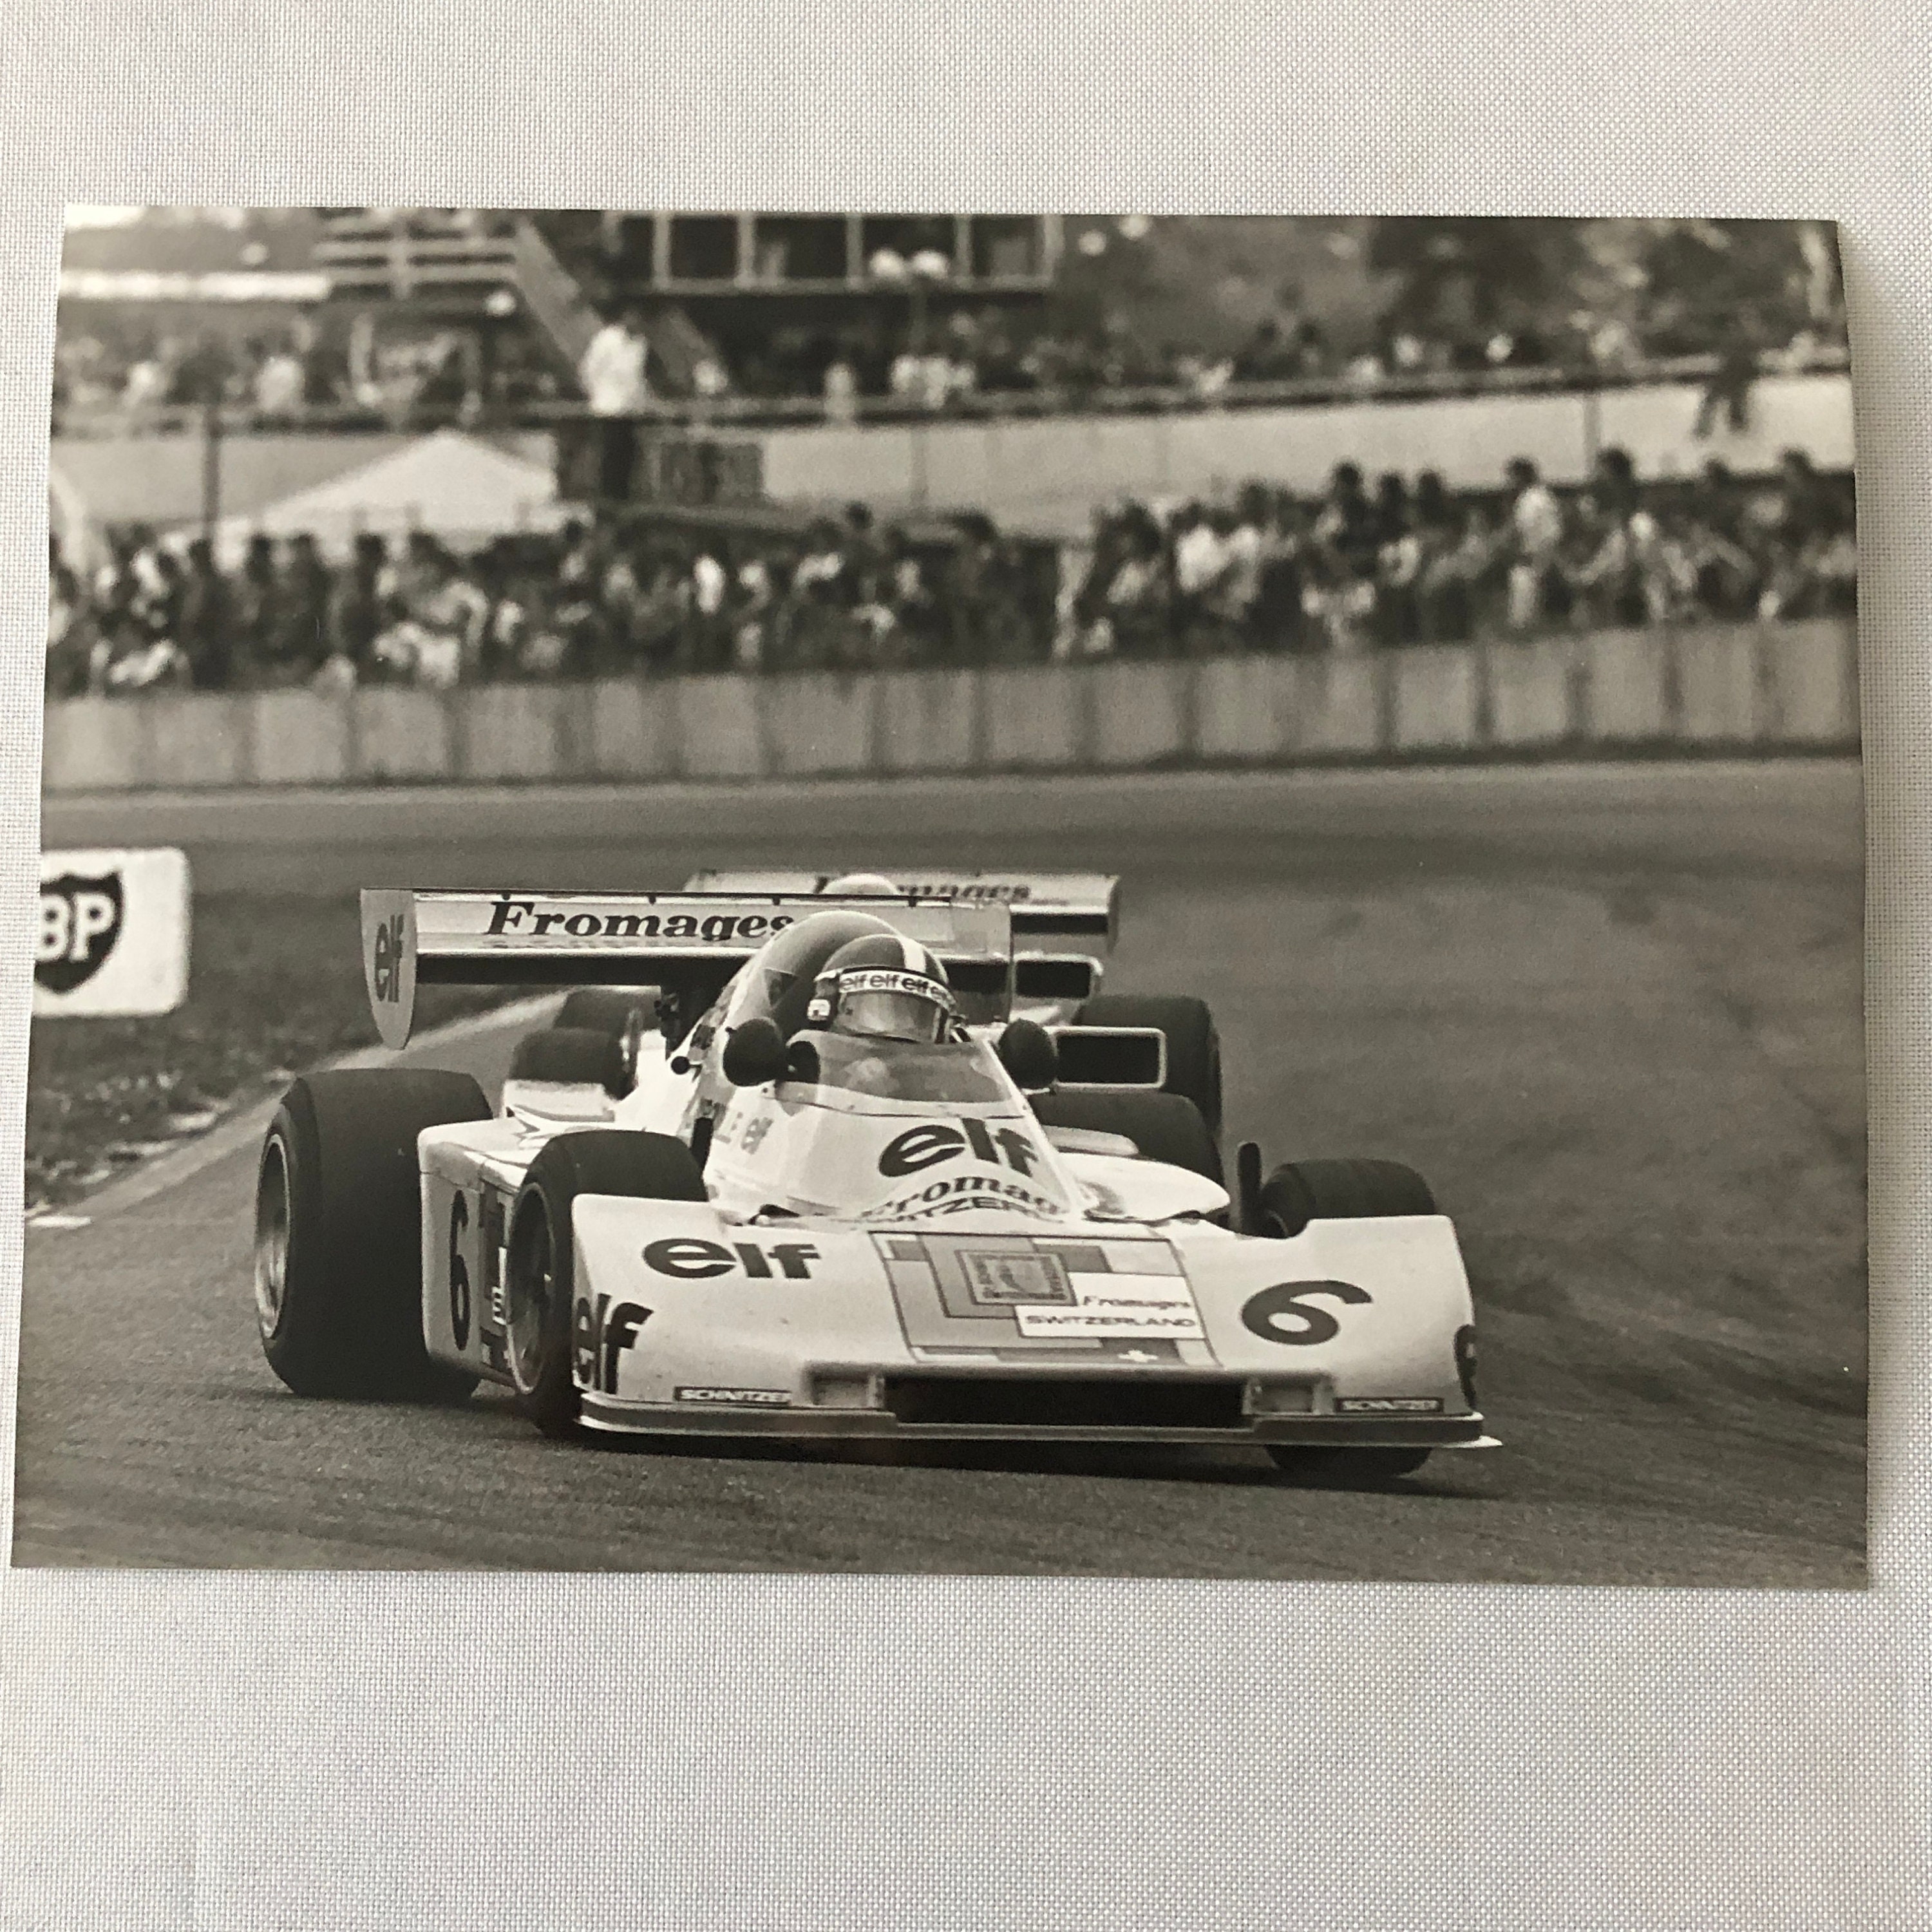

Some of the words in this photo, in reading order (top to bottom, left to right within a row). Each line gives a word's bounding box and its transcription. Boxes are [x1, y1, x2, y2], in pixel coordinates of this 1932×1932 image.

[37, 893, 115, 961] BP
[484, 901, 795, 941] Fromages
[375, 914, 404, 1002] elf
[839, 974, 867, 991] elf
[870, 974, 900, 988] elf
[879, 1117, 1039, 1177] elf
[450, 1190, 470, 1351] 6
[642, 1238, 821, 1278] elf
[572, 1293, 654, 1395] elf
[1241, 1280, 1373, 1346] 6
